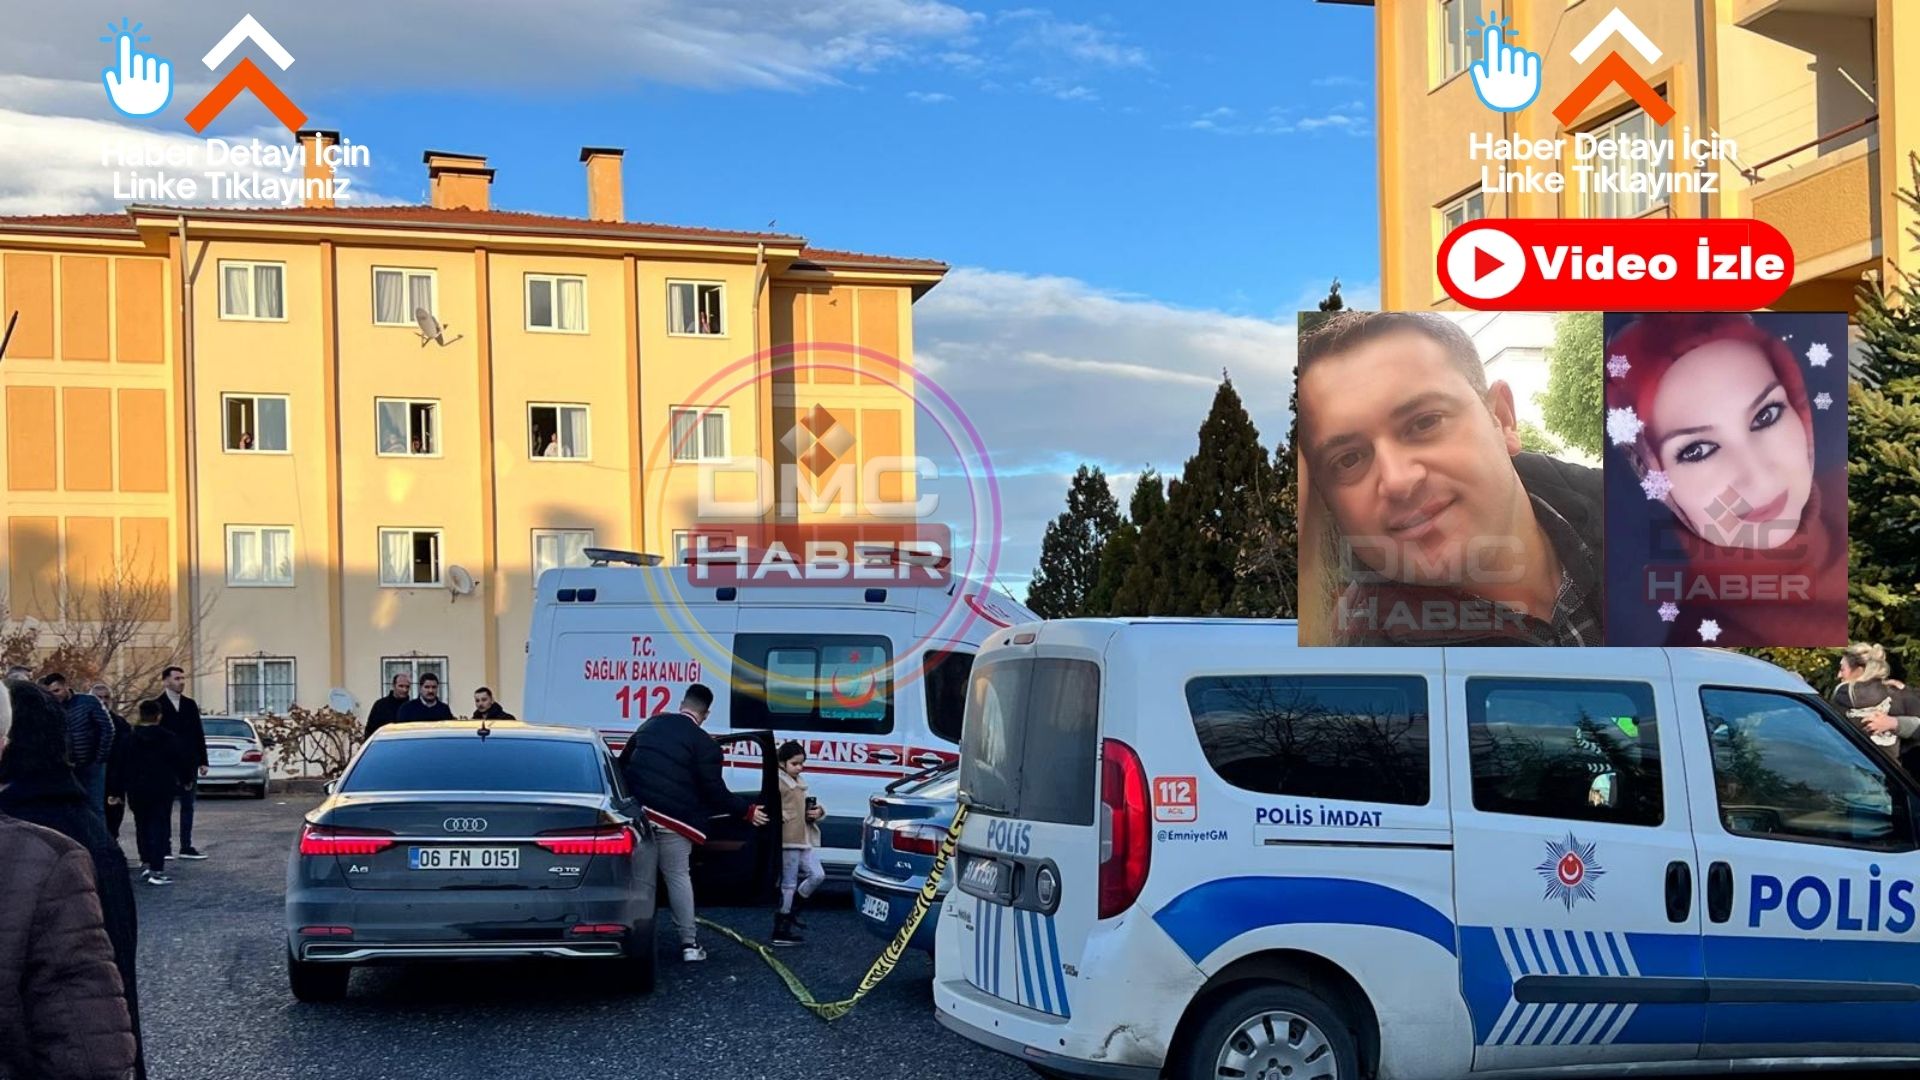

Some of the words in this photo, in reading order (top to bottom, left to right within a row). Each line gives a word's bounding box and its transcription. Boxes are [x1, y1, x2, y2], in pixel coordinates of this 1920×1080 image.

[631, 636, 656, 657] T.C.
[584, 656, 628, 680] SAĞLIK
[632, 658, 702, 683] BAKANLIĞI
[615, 685, 671, 719] 112
[1159, 781, 1191, 803] 112
[1255, 804, 1313, 826] POLİS
[1319, 804, 1383, 827] İMDAT
[987, 819, 1032, 855] POLİS
[1157, 829, 1228, 842] @EmniyetGM
[350, 864, 369, 874] A6
[419, 850, 440, 867] 06
[451, 851, 471, 867] FN
[481, 850, 518, 867] 0151
[1748, 862, 1916, 933] POLİS
